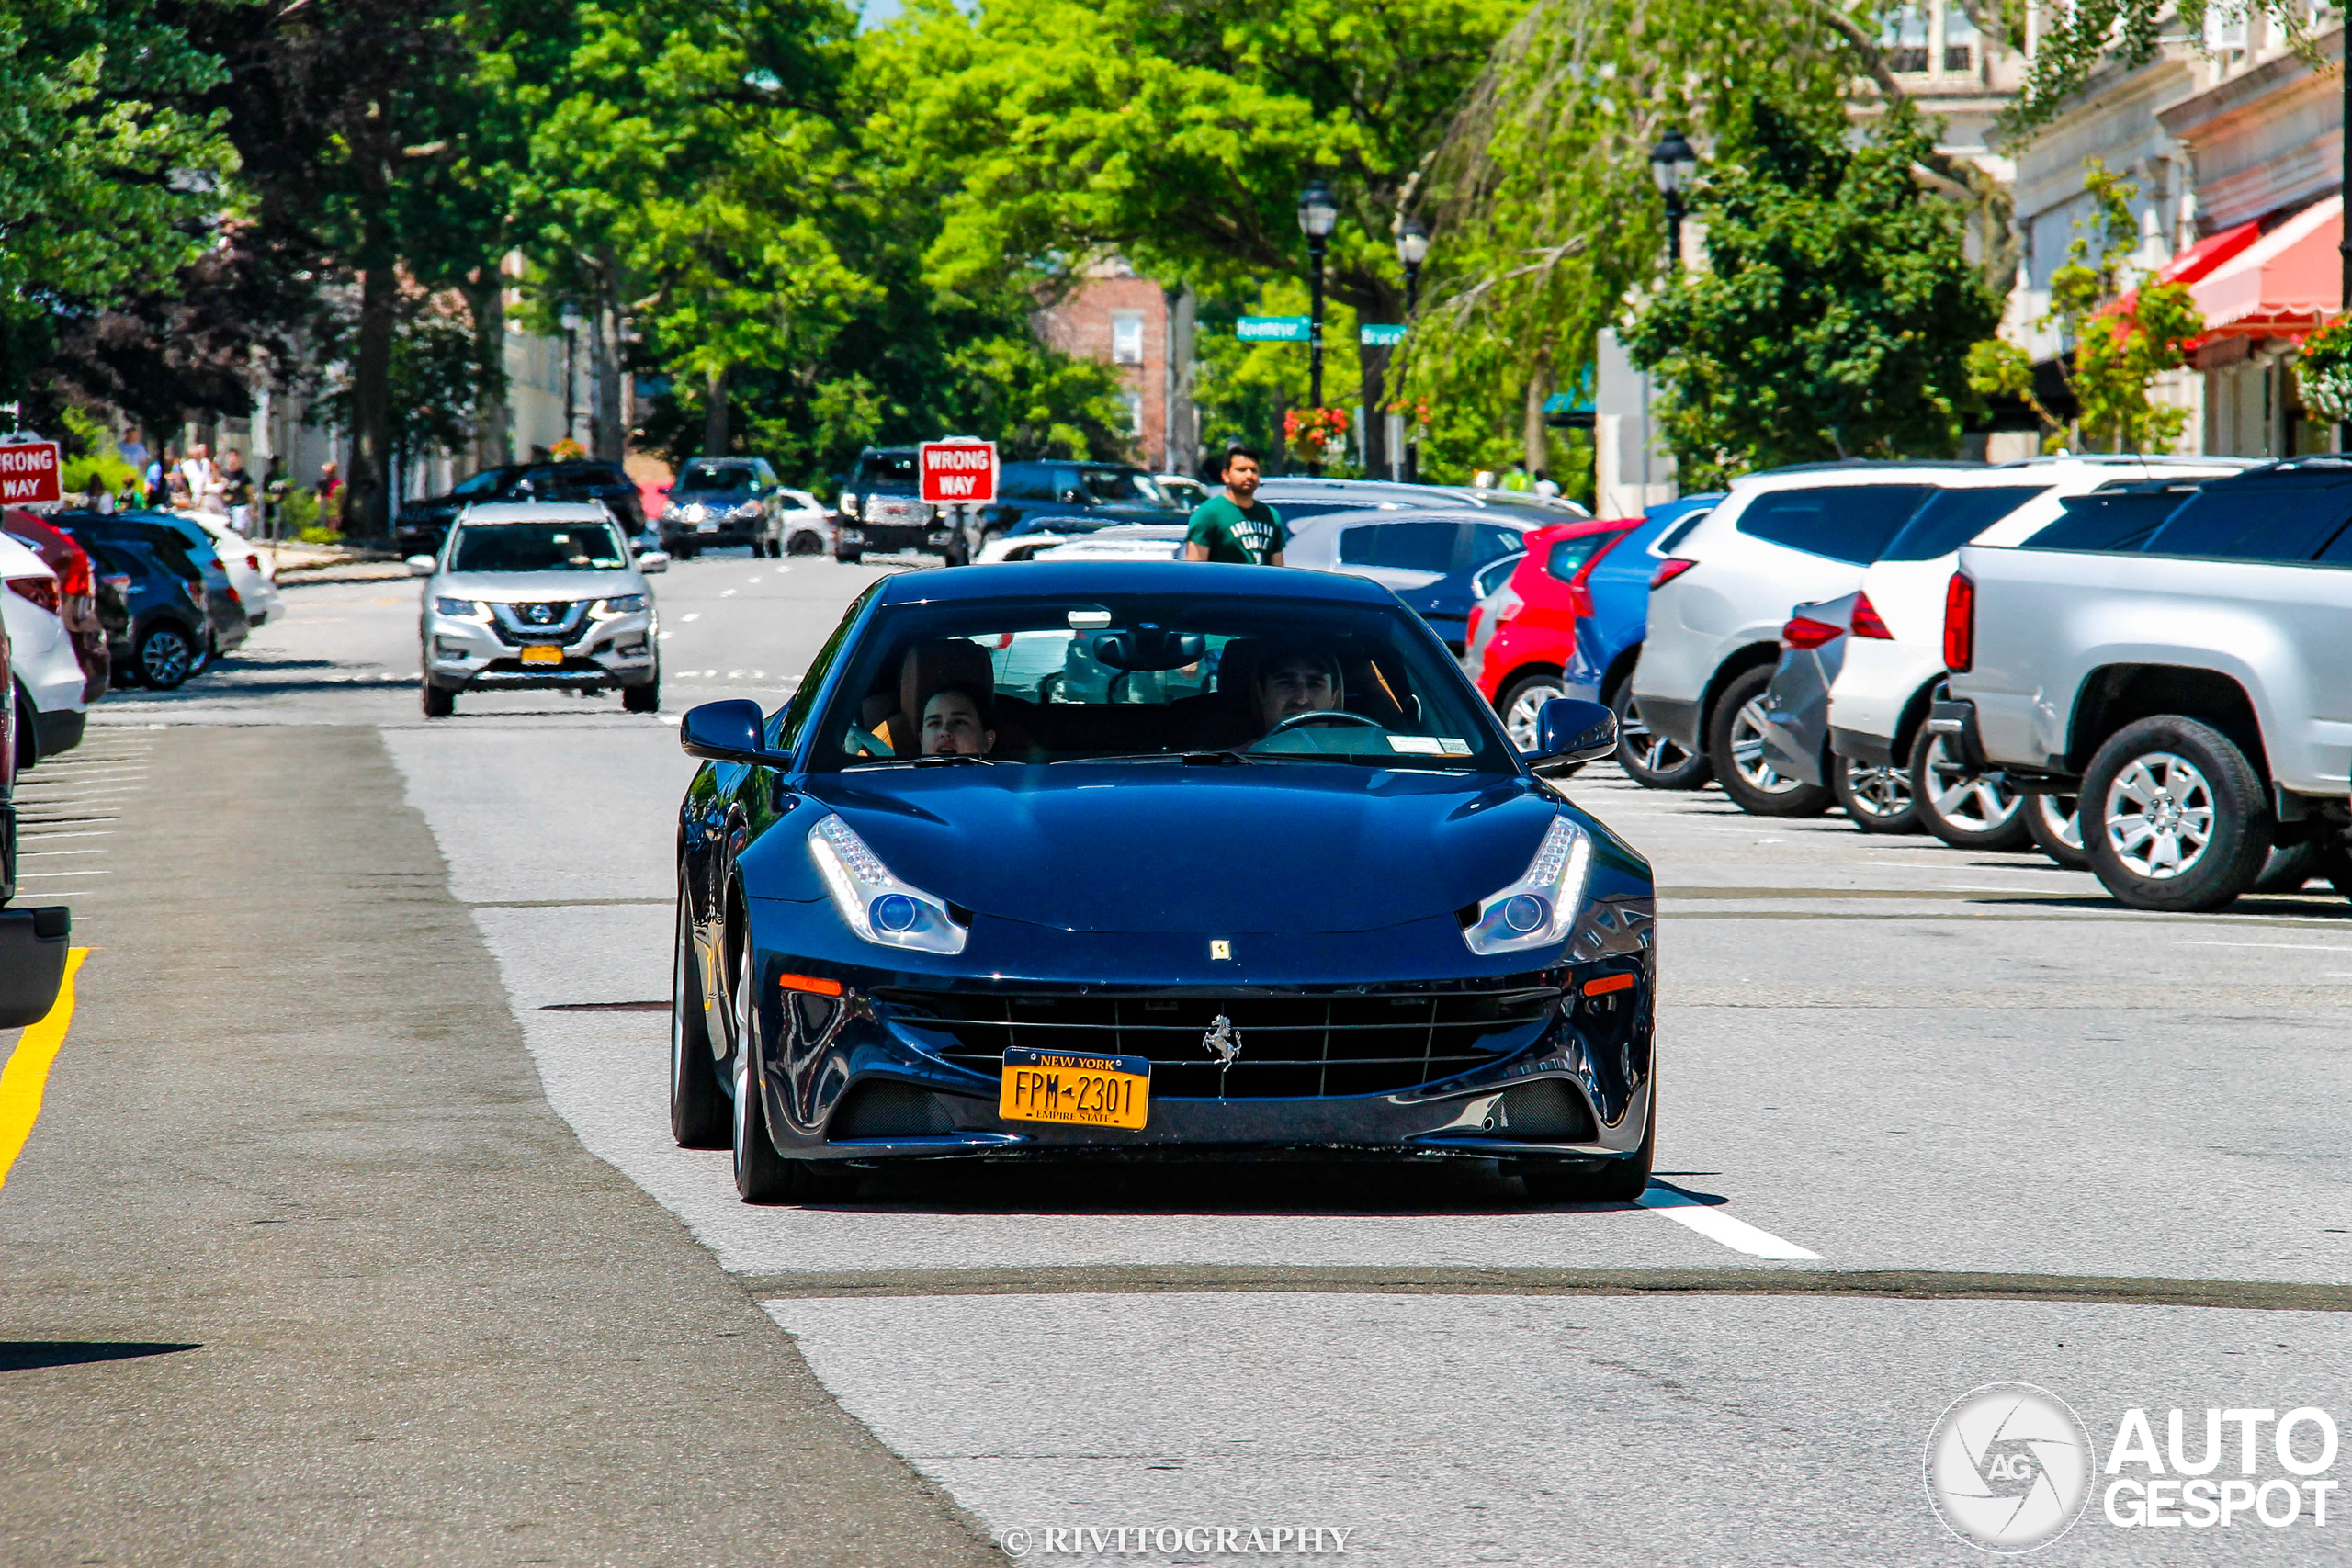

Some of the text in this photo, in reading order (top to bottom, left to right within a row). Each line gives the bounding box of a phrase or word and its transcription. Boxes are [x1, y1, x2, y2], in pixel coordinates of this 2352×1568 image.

[0, 450, 52, 473] RONG
[926, 450, 989, 470] WRONG
[3, 478, 40, 499] WAY
[939, 475, 977, 495] WAY
[1229, 521, 1273, 537] AMERICAN
[1241, 535, 1269, 550] EAGLE
[1040, 1055, 1115, 1071] NEW YORK
[1076, 1076, 1132, 1114] 2301
[1035, 1109, 1111, 1123] EMPIRE STATE
